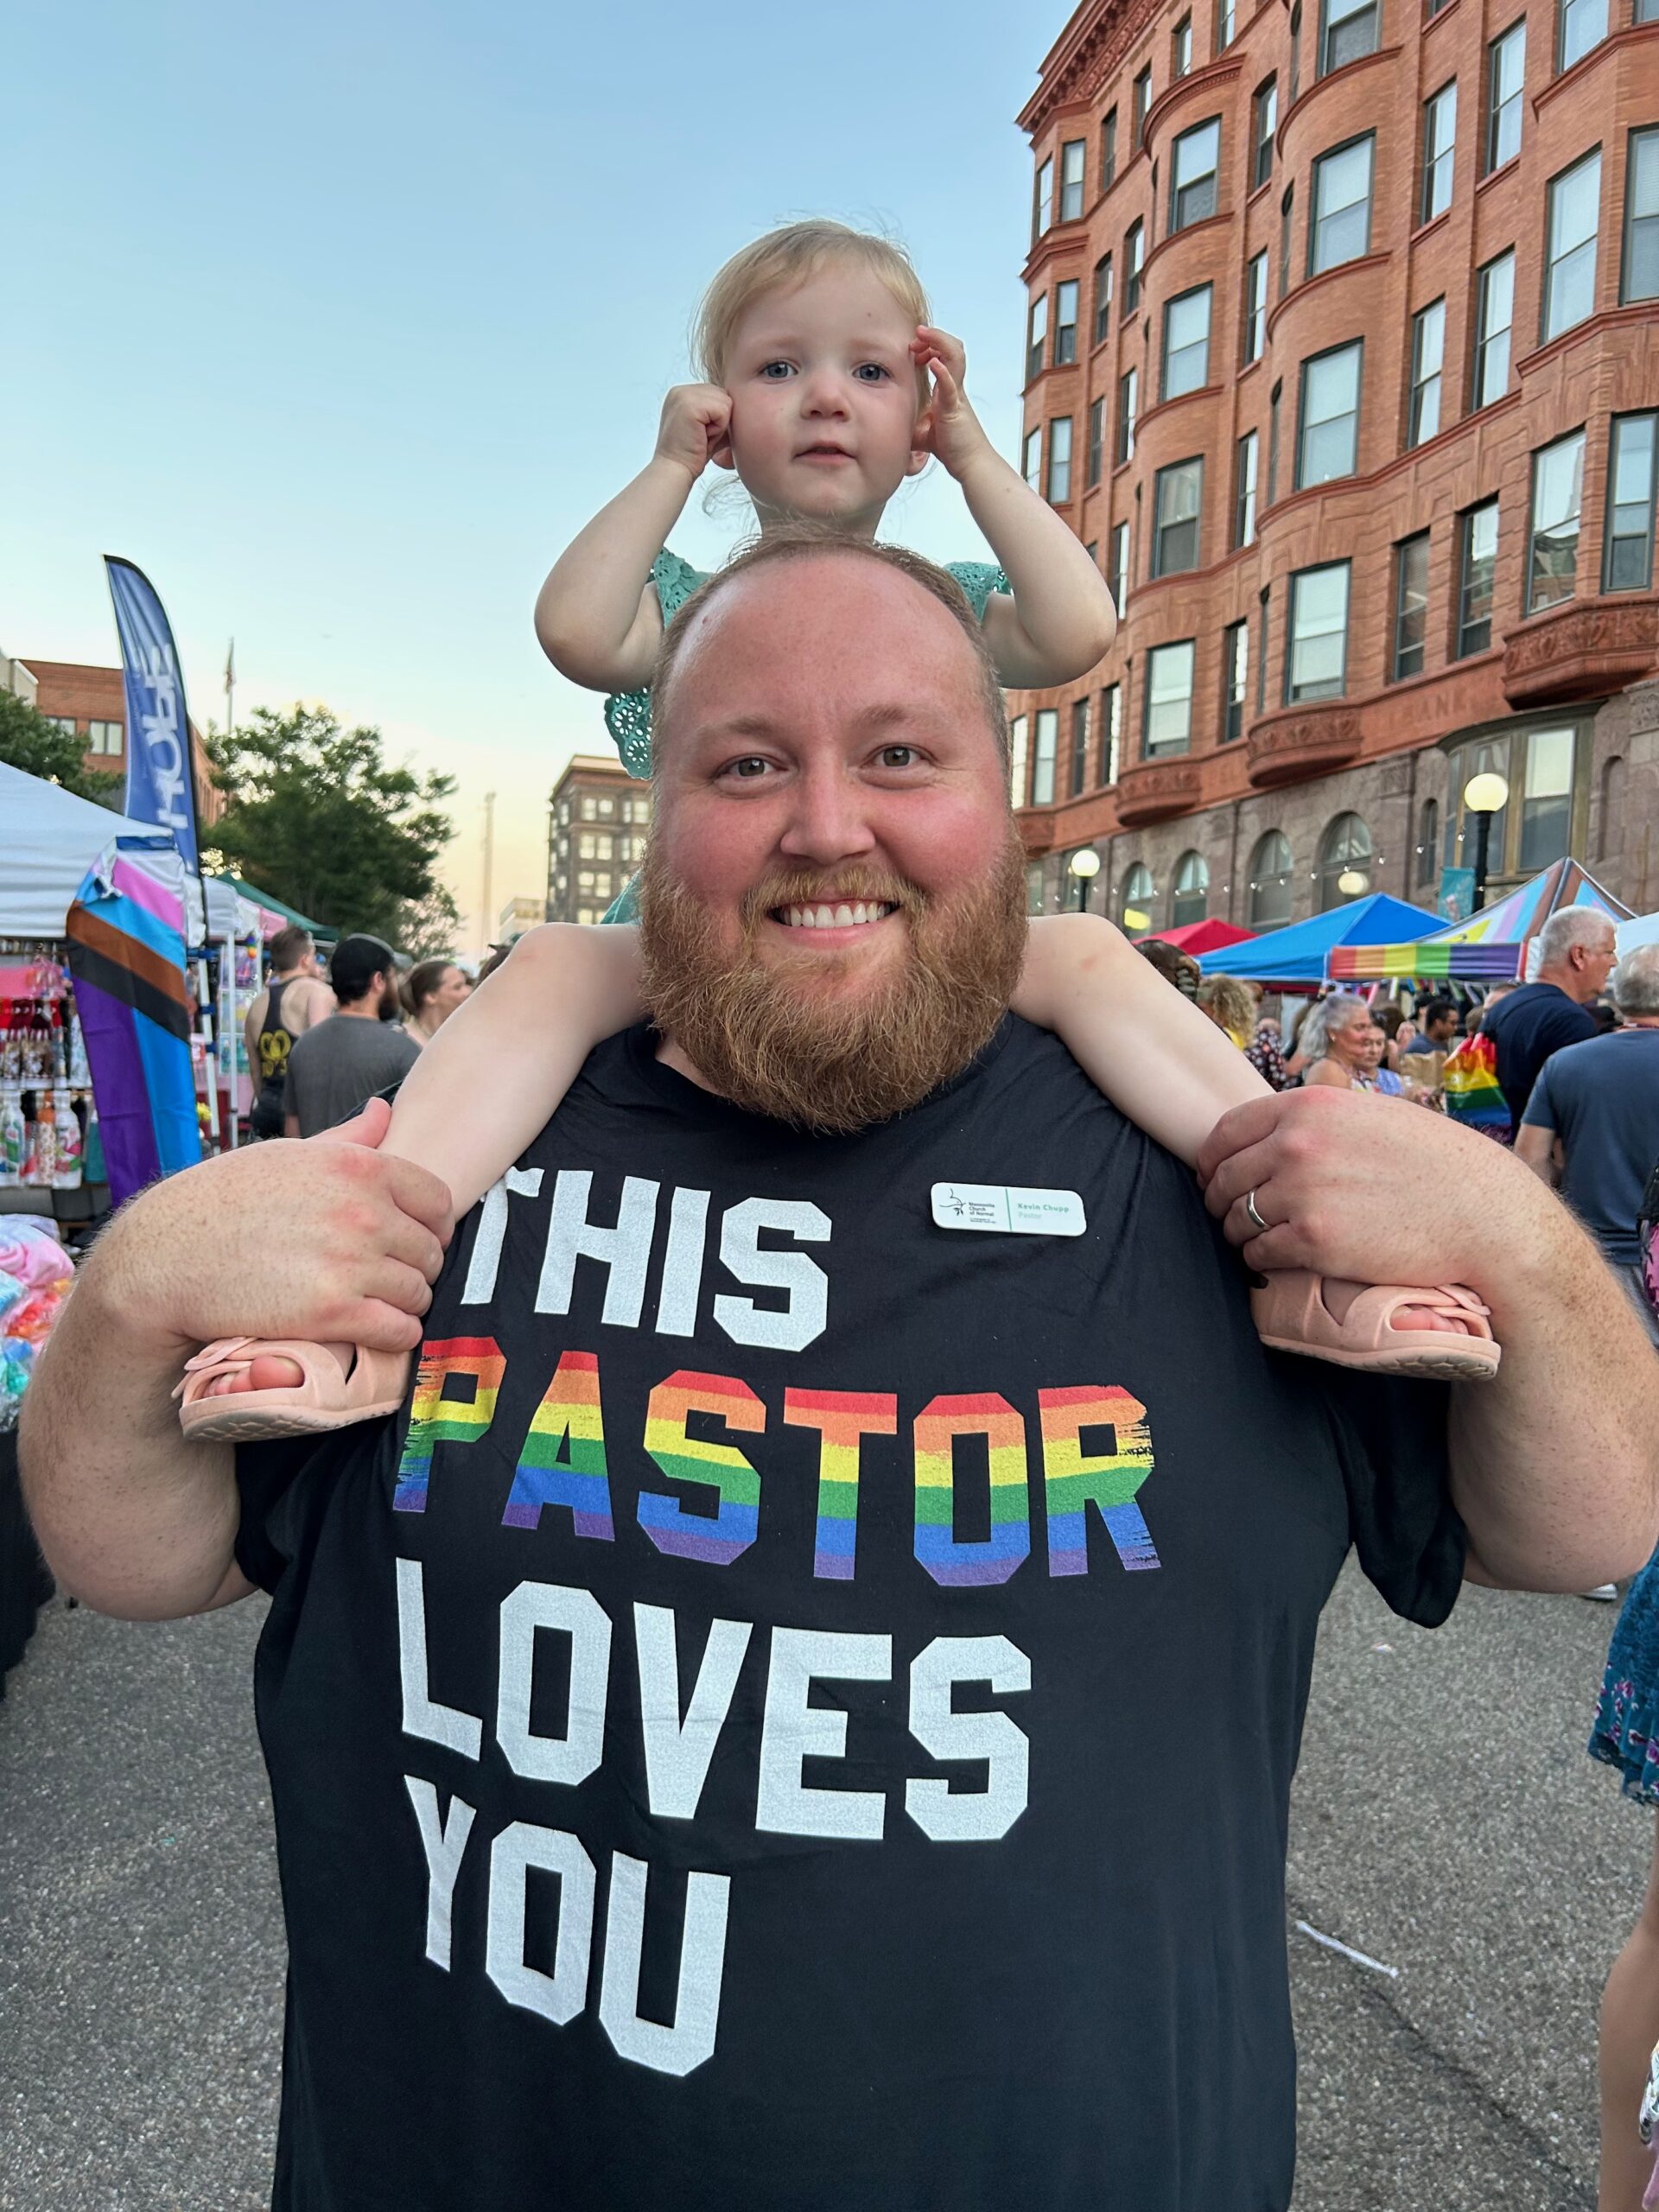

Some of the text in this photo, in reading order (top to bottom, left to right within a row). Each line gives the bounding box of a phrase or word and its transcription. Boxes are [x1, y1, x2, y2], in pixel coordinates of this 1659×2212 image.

[460, 1165, 832, 1352] THIS
[1043, 1205, 1070, 1213] Chupp
[393, 1336, 1161, 1586] PASTOR
[396, 1557, 1032, 1841] LOVES
[404, 1774, 731, 2076] YOU
